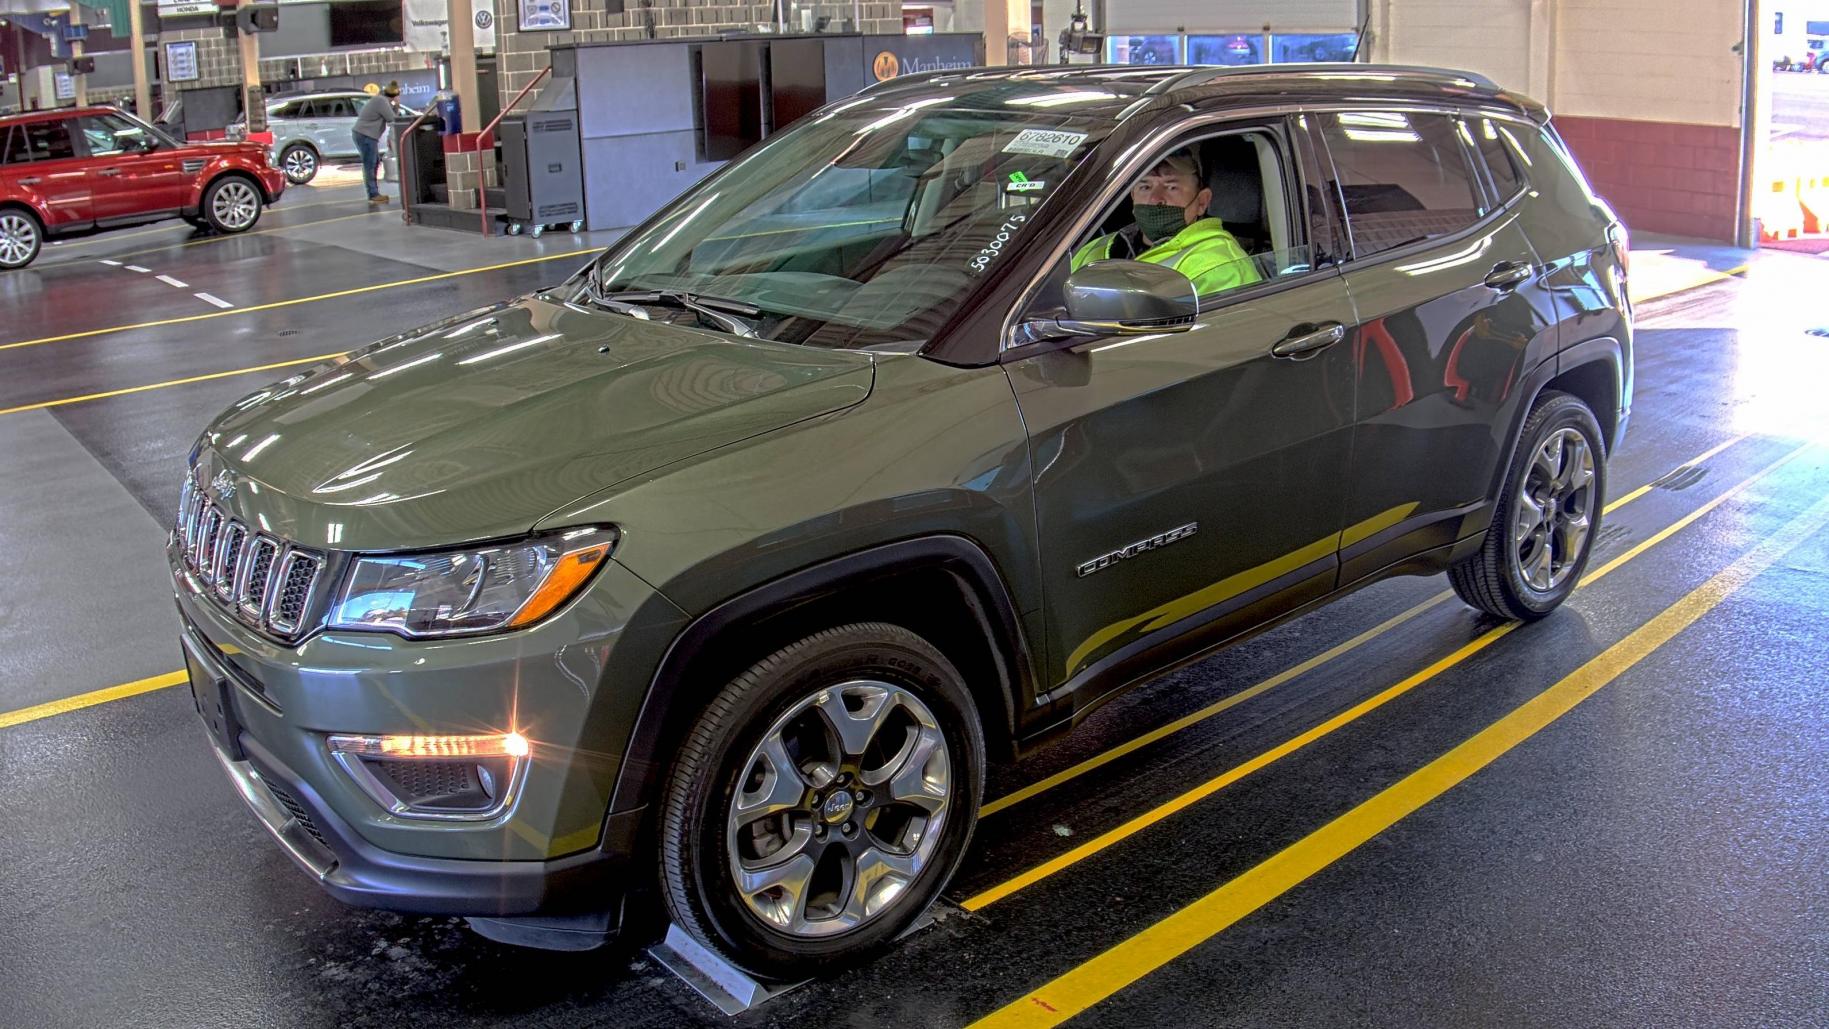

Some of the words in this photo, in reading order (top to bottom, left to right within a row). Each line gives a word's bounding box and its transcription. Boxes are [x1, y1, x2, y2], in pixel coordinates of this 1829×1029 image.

[902, 57, 972, 75] Manheim
[1019, 131, 1081, 146] 6782610
[1077, 521, 1199, 578] COMPASS
